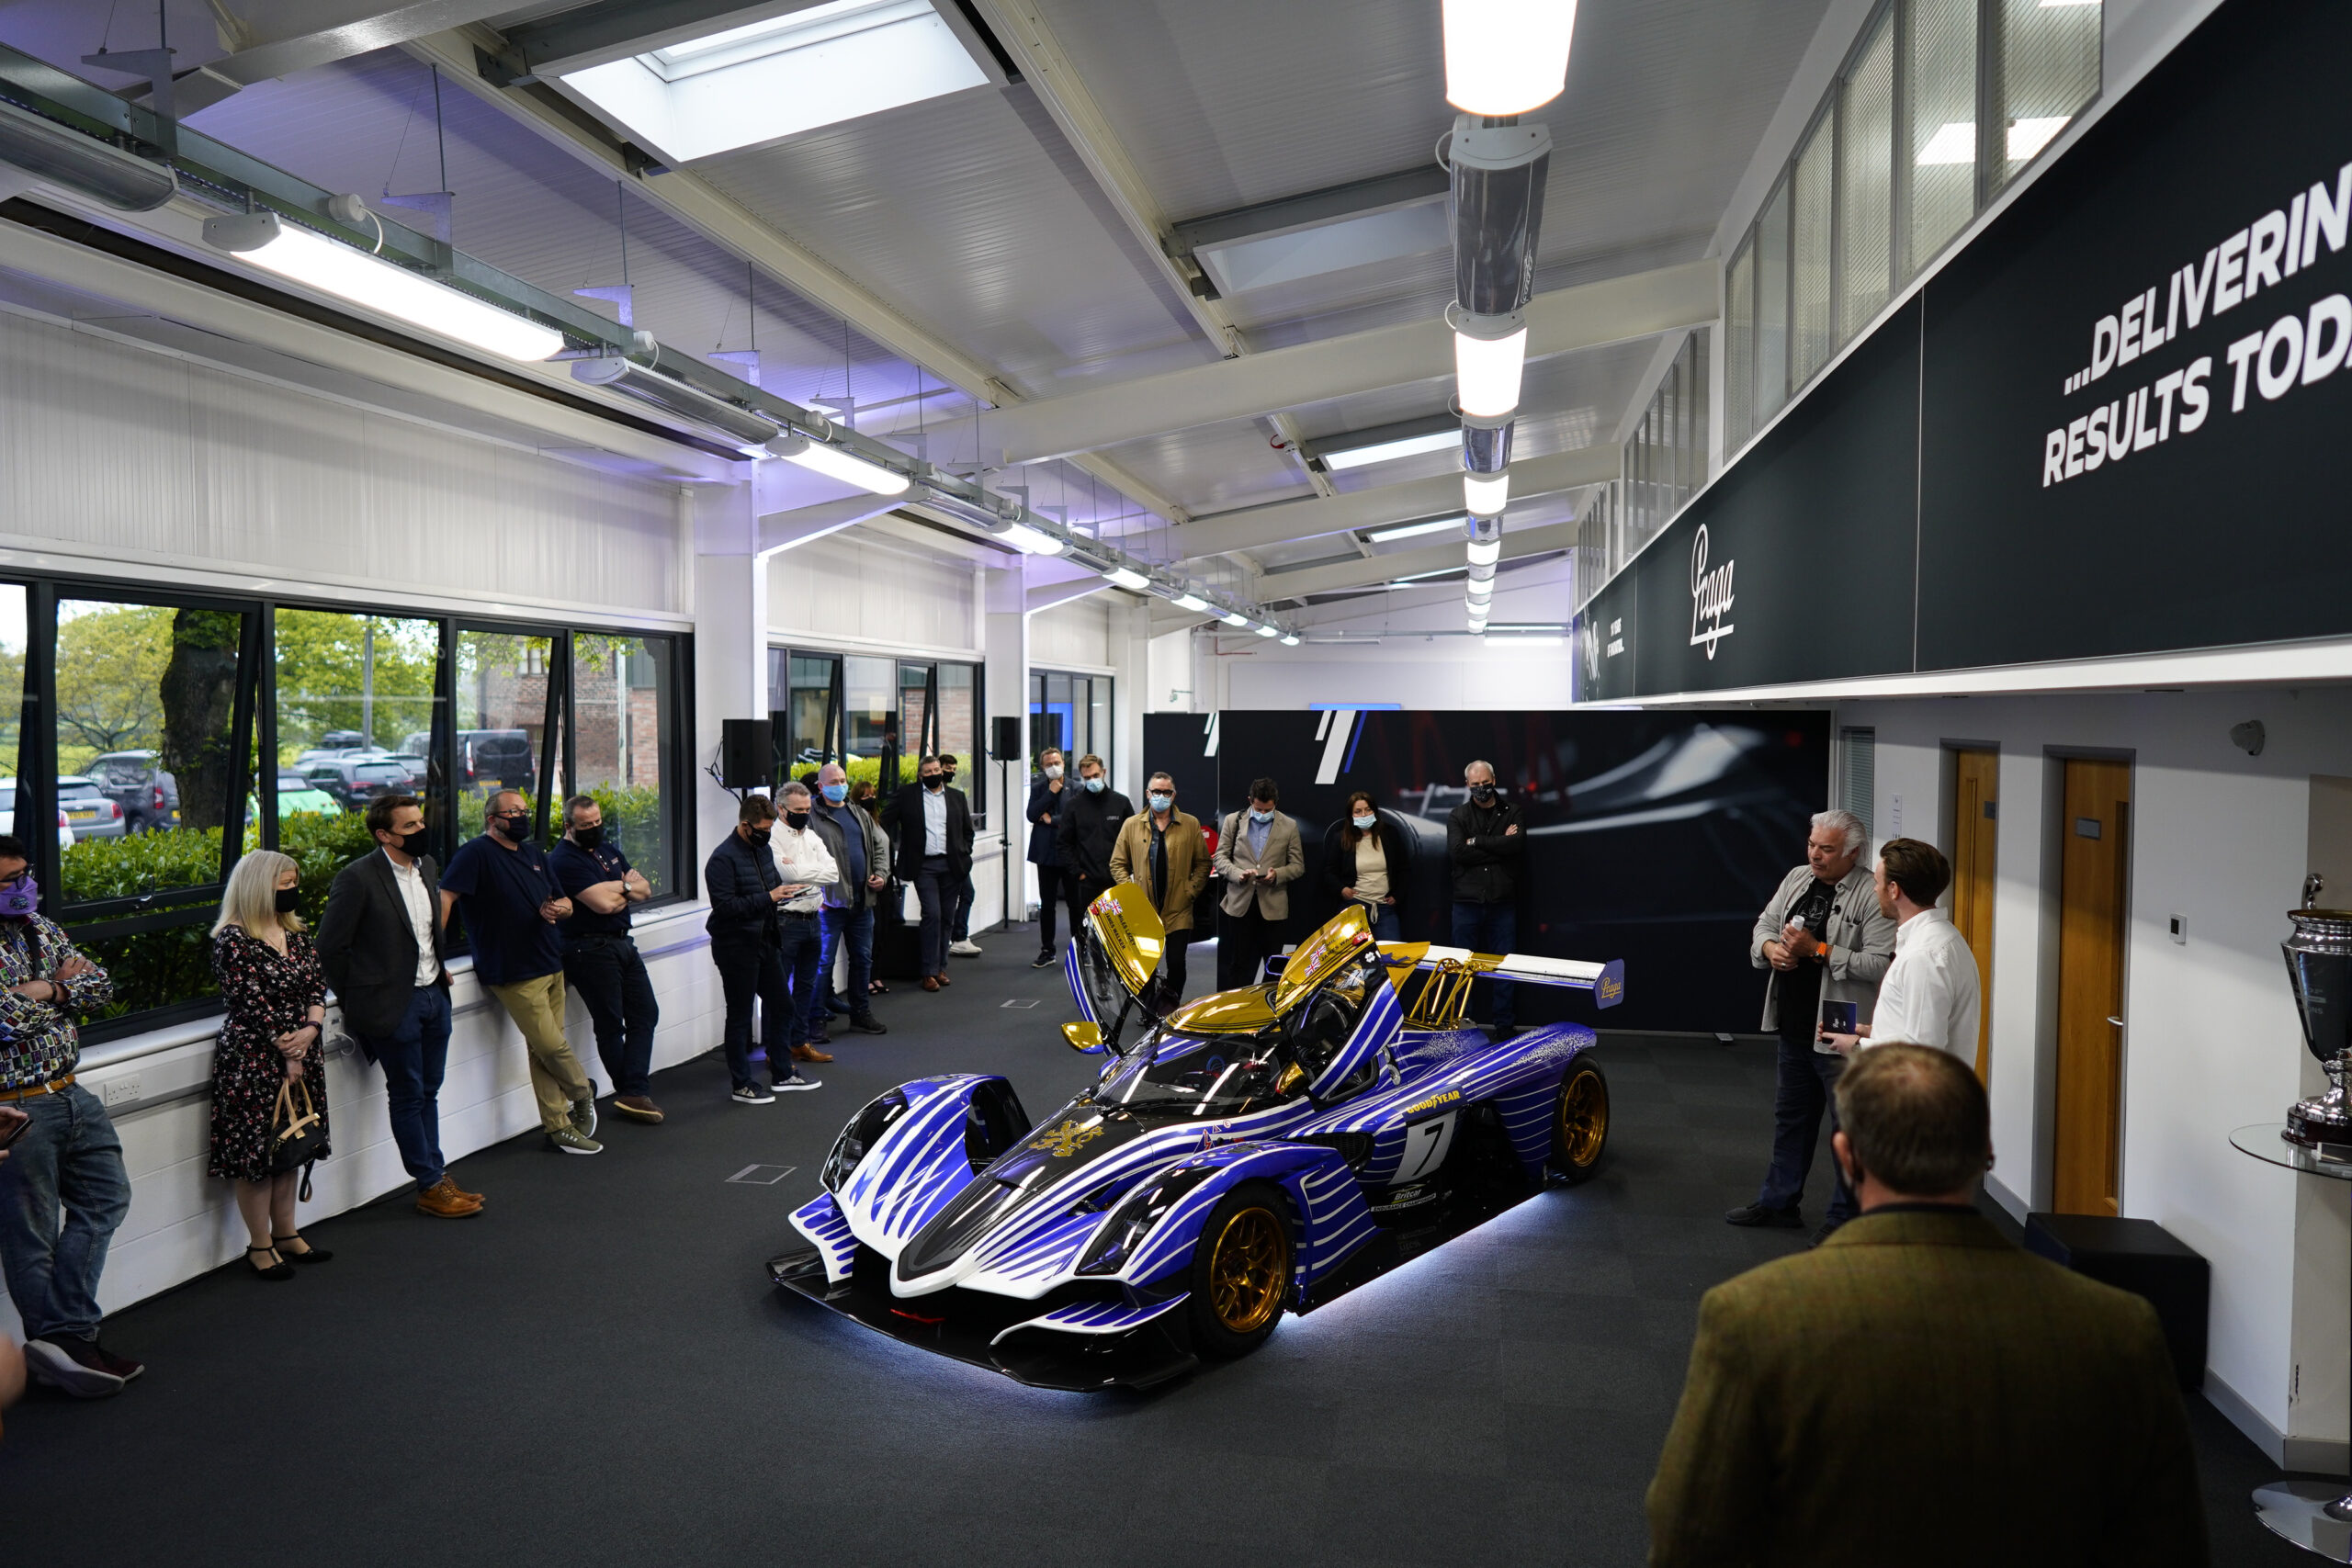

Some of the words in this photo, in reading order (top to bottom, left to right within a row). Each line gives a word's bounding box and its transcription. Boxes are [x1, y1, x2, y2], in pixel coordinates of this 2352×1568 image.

[2043, 356, 2212, 488] RESULTS
[2227, 293, 2352, 412] TOD
[1690, 523, 1735, 660] Praga
[1104, 912, 1114, 929] JAMES
[1113, 928, 1126, 950] WALKER
[1601, 977, 1622, 998] Praga
[1407, 1090, 1461, 1113] GOODYEAR
[1412, 1122, 1444, 1176] 7
[1395, 1189, 1422, 1201] Britcar
